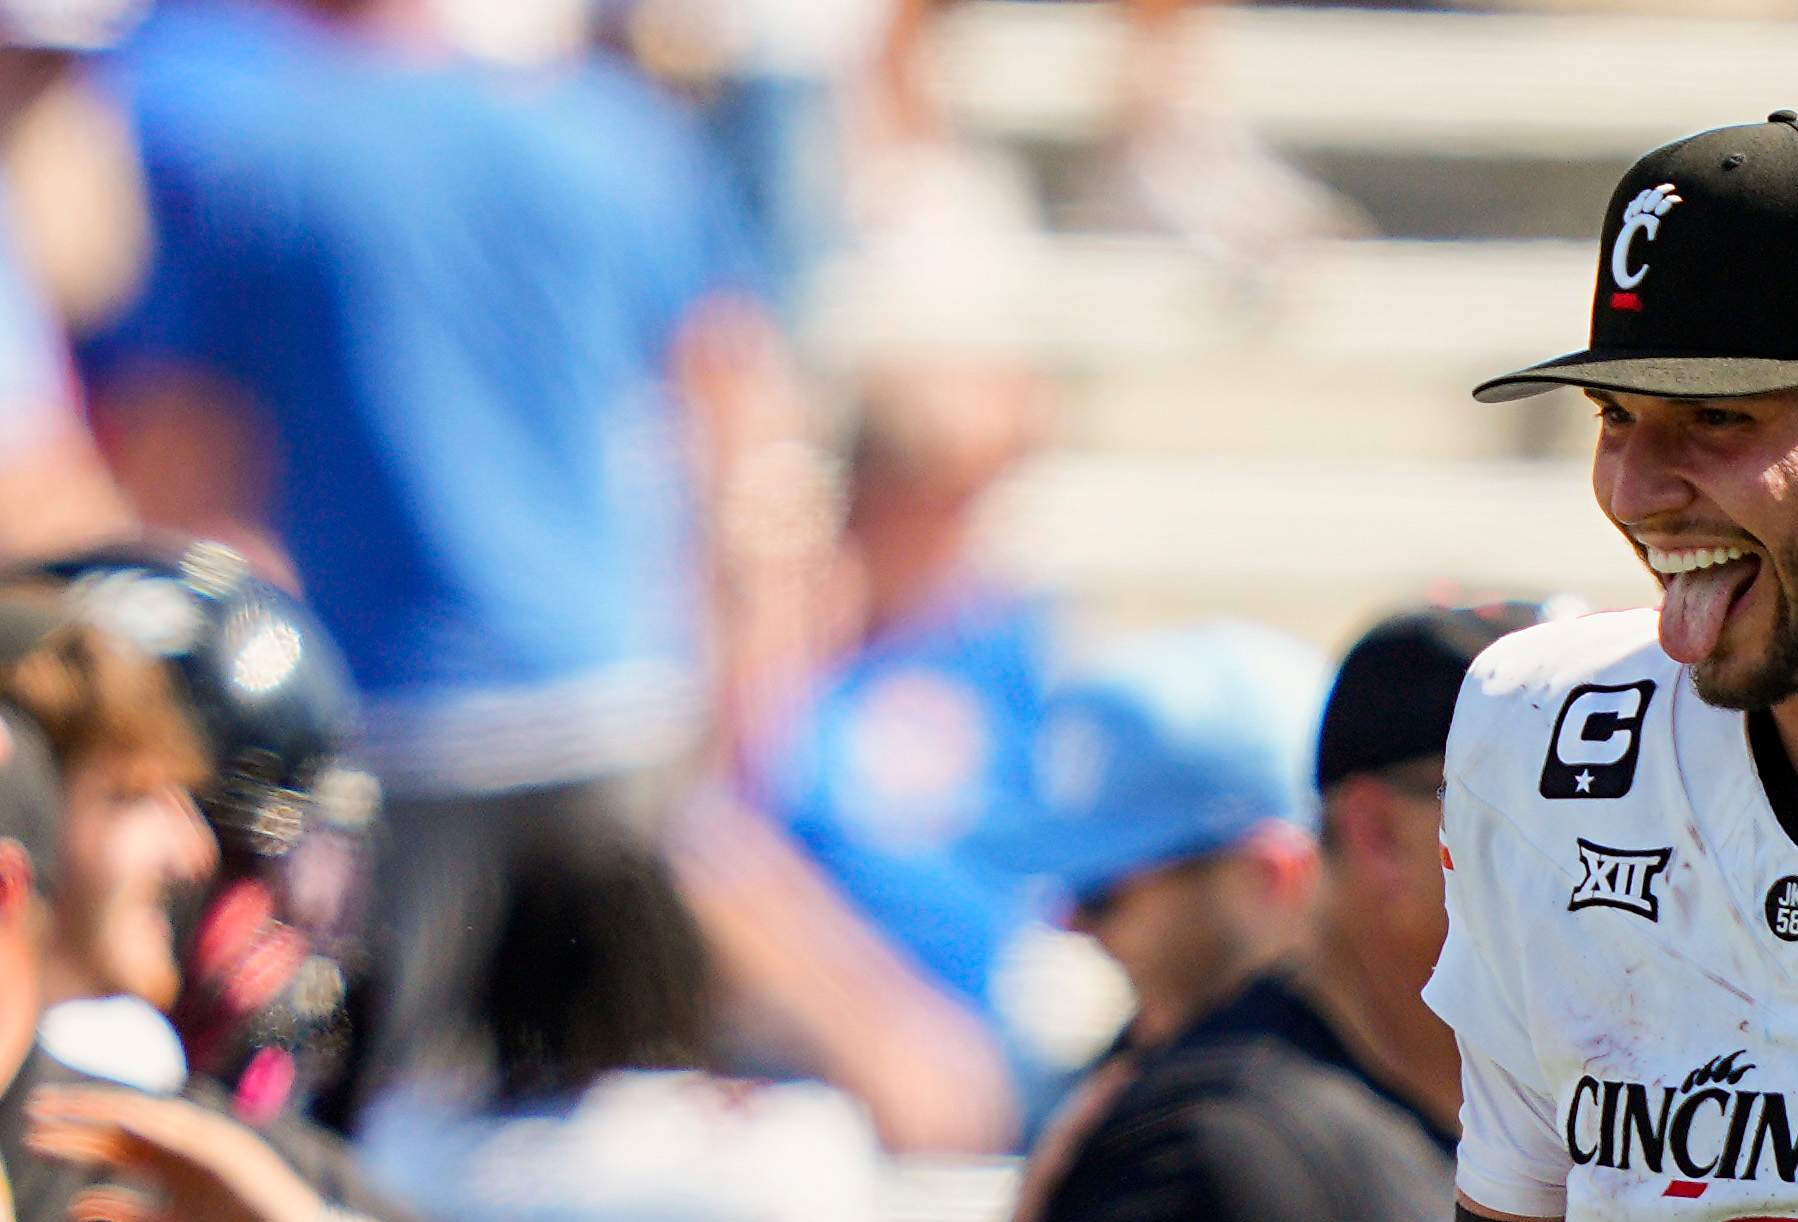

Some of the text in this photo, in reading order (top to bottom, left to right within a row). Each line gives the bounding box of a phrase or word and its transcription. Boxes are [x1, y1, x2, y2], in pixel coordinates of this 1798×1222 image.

[1612, 208, 1662, 290] C
[1556, 690, 1641, 765] C
[1574, 848, 1661, 911] XII
